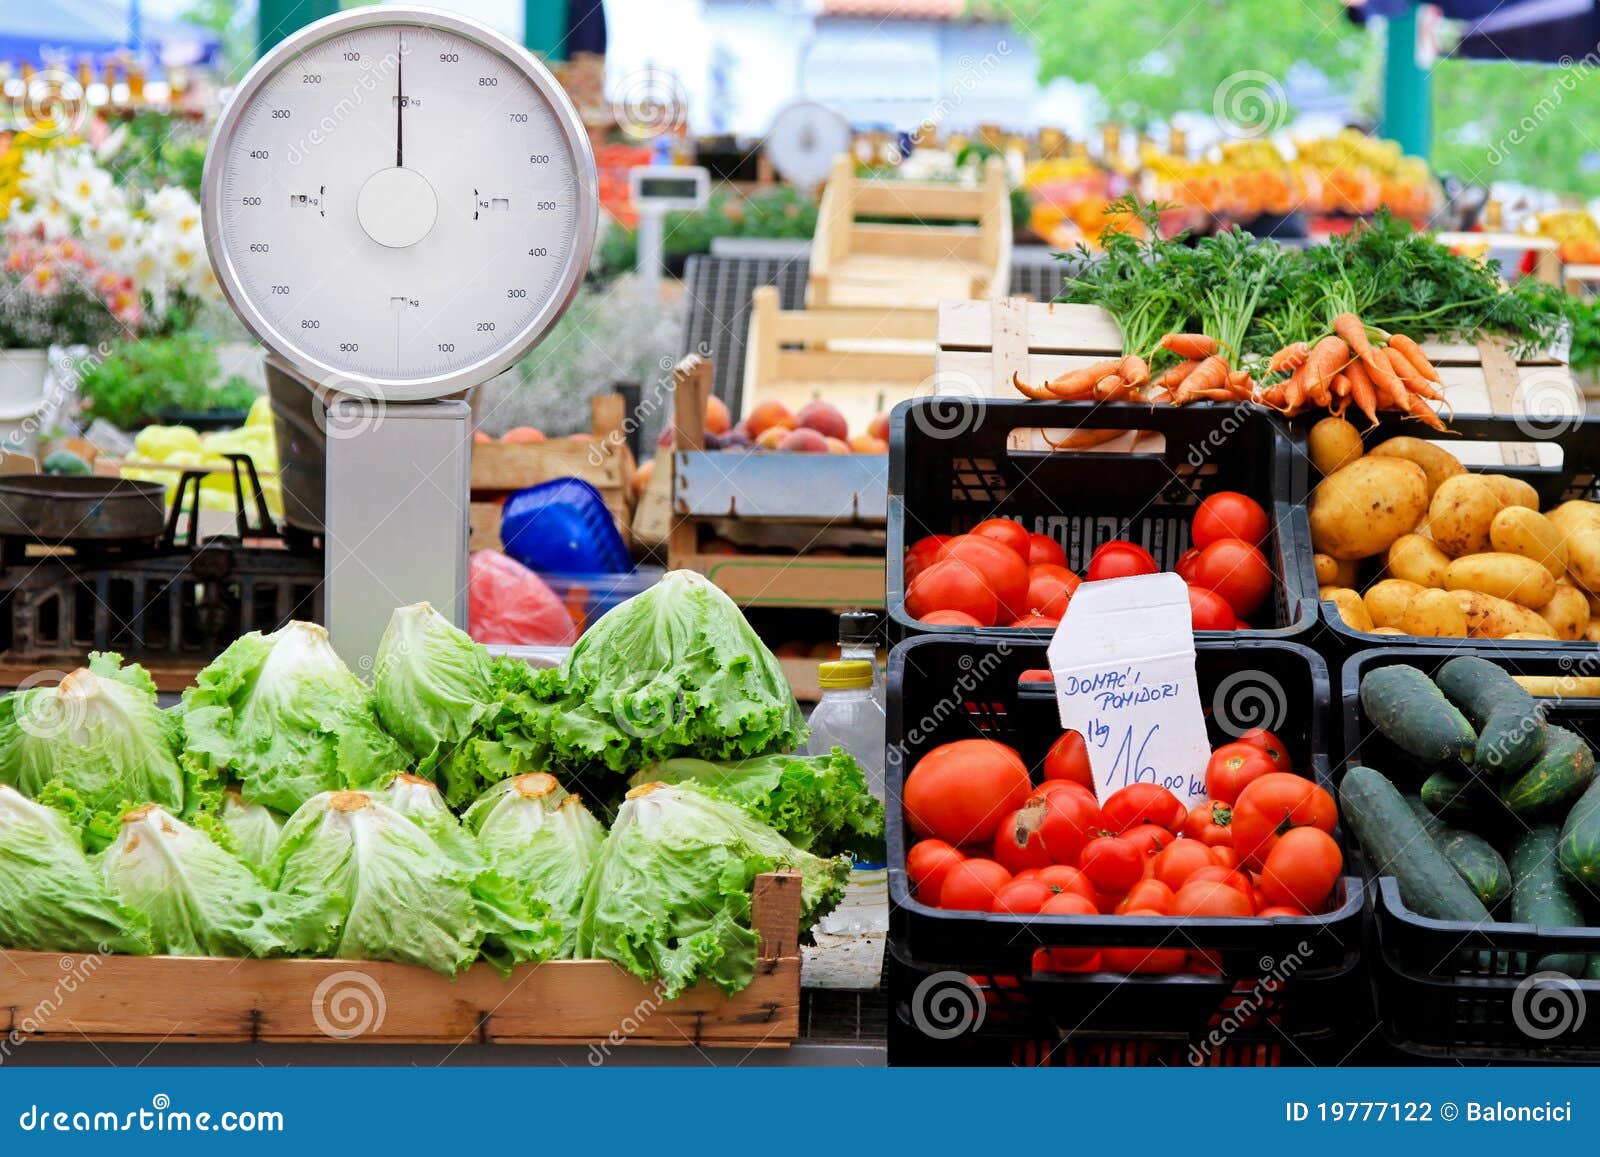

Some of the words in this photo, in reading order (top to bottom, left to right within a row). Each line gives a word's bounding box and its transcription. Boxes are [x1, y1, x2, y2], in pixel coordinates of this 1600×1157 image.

[343, 51, 361, 62] 100
[439, 52, 459, 63] 900
[302, 74, 322, 84] 200
[478, 77, 498, 87] 800
[271, 109, 291, 119] 300
[509, 113, 529, 123] 700
[249, 150, 270, 160] 400
[529, 154, 550, 165] 600
[241, 196, 262, 206] 500
[479, 200, 489, 208] kg
[536, 200, 557, 211] 500
[249, 243, 270, 253] 600
[527, 247, 548, 257] 400
[271, 285, 290, 295] 700
[507, 289, 527, 300] 300
[409, 298, 419, 307] kg
[300, 319, 321, 329] 800
[476, 321, 496, 332] 200
[339, 342, 360, 353] 900
[437, 343, 456, 353] 100
[1095, 684, 1178, 710] POMIDORI
